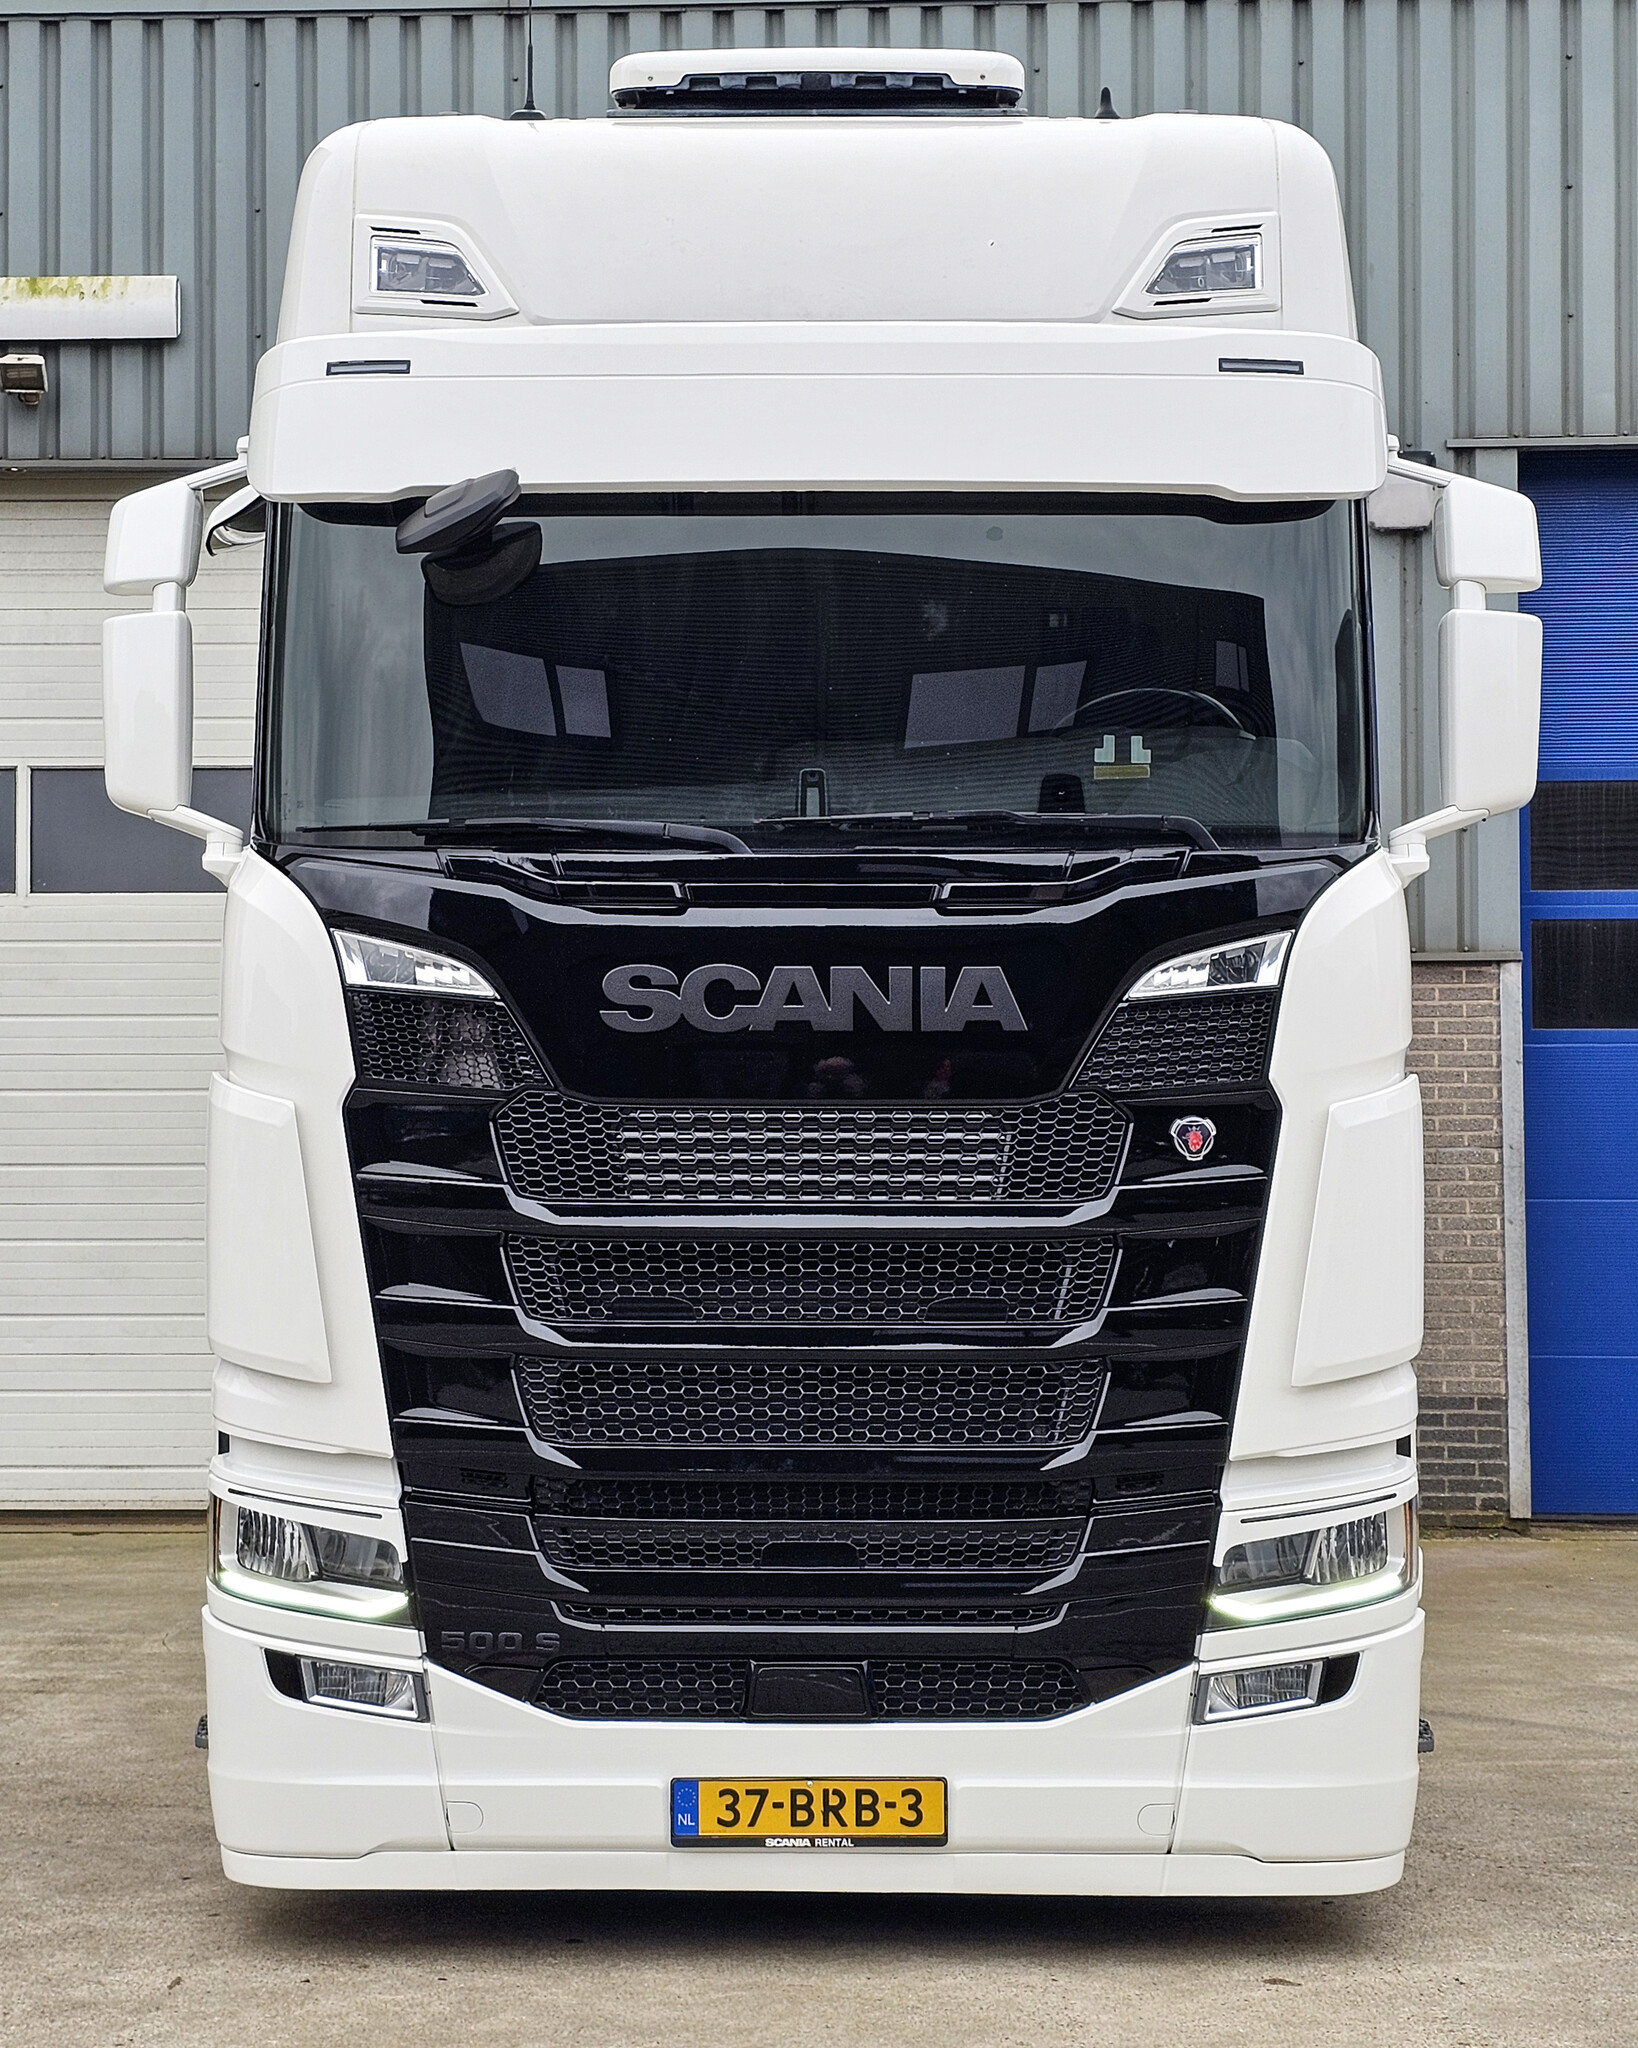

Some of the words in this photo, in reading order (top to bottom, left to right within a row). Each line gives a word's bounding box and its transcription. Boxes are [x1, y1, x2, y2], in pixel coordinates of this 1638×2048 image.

[599, 963, 1029, 1033] SCANIA
[440, 1630, 522, 1651] 500
[535, 1631, 560, 1652] S
[716, 1787, 923, 1828] 37-BRB-3
[677, 1813, 695, 1826] NL
[764, 1838, 811, 1847] SCANIA
[815, 1838, 854, 1847] RENTAL
